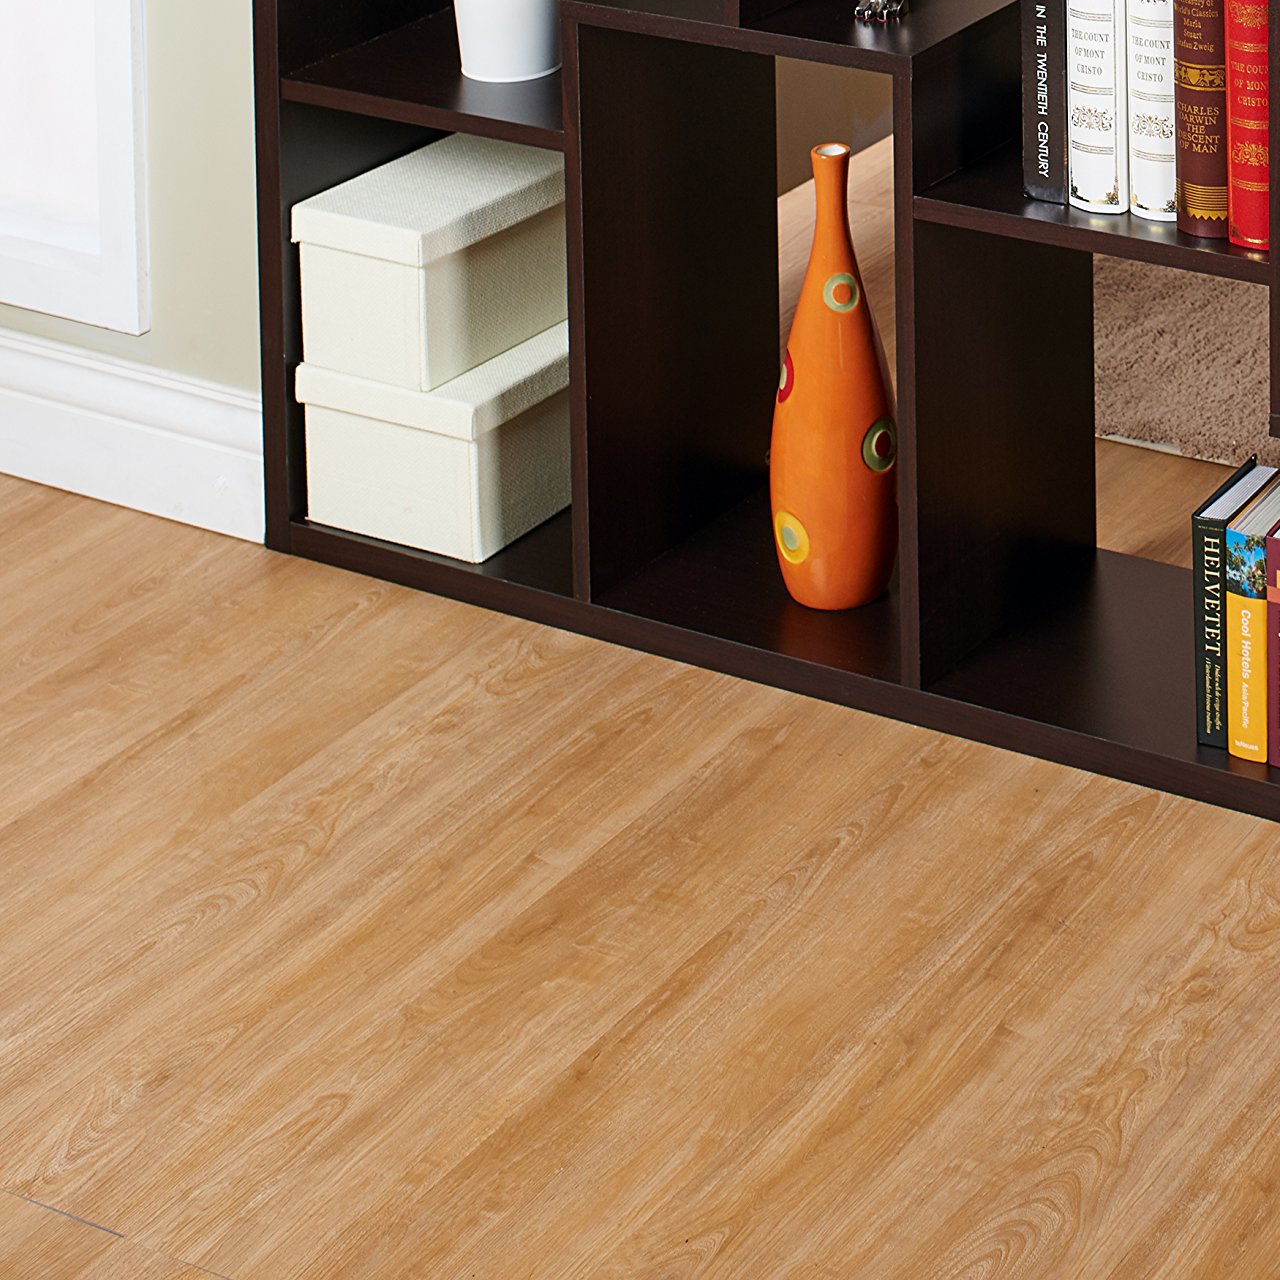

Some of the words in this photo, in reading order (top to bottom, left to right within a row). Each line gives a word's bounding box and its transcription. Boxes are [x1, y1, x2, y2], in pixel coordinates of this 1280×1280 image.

[1035, 3, 1047, 18] IN
[1191, 8, 1219, 18] Classics
[1036, 24, 1047, 47] THE
[1071, 28, 1083, 40] THE
[1083, 32, 1110, 43] COUNT
[1131, 35, 1144, 47] THE
[1144, 38, 1171, 50] COUNT
[1074, 46, 1083, 57] OF
[1083, 48, 1105, 59] MONT
[1134, 53, 1143, 64] OF
[1143, 55, 1167, 66] MONT
[1076, 63, 1103, 76] CRISTO
[1230, 61, 1245, 73] THE
[1136, 70, 1164, 83] CRISTO
[1234, 79, 1244, 88] OF
[1036, 53, 1048, 116] TWENTIETH
[1177, 101, 1220, 116] CHARLES
[1237, 96, 1268, 107] CRISTO
[1179, 112, 1217, 126] DARWIN
[1185, 122, 1206, 135] THE
[1177, 129, 1220, 144] DESCENT
[1037, 121, 1049, 178] CENTURY
[1179, 139, 1190, 150] OF
[1192, 143, 1218, 153] MAN
[1204, 535, 1222, 657] HELVETET
[1241, 609, 1252, 637] Cool
[1241, 640, 1253, 679] Hotels
[1240, 681, 1250, 728] Asia/Pacific
